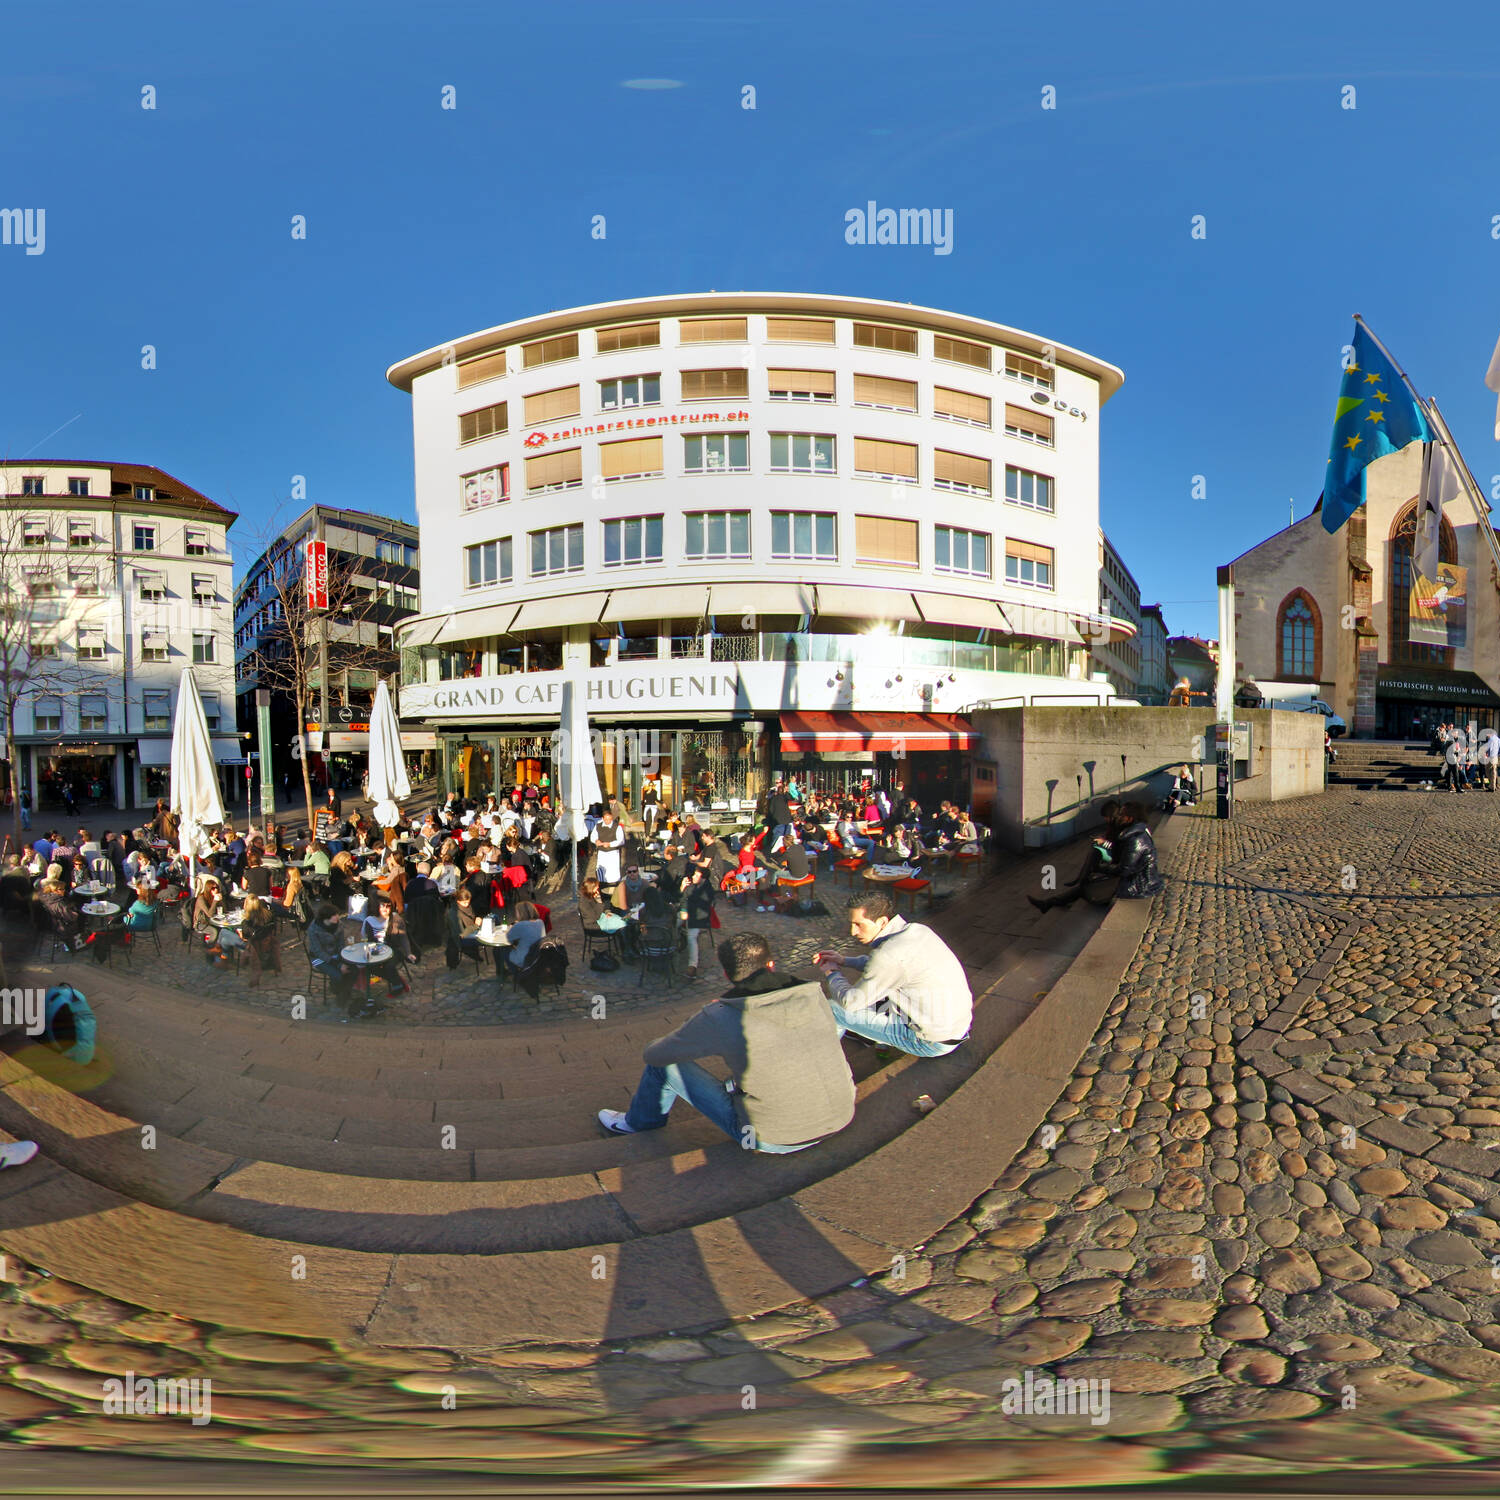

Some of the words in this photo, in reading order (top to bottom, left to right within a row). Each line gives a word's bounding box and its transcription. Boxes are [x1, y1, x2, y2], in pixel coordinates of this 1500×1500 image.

[552, 411, 749, 439] zahnarztzentrum.ch
[434, 687, 504, 709] GRAND
[515, 683, 559, 704] CAF
[588, 675, 740, 700] HUGUENIN
[1379, 680, 1434, 691] HISTORISCHES
[1437, 685, 1468, 694] MUSEUM
[1471, 688, 1490, 696] BASEL
